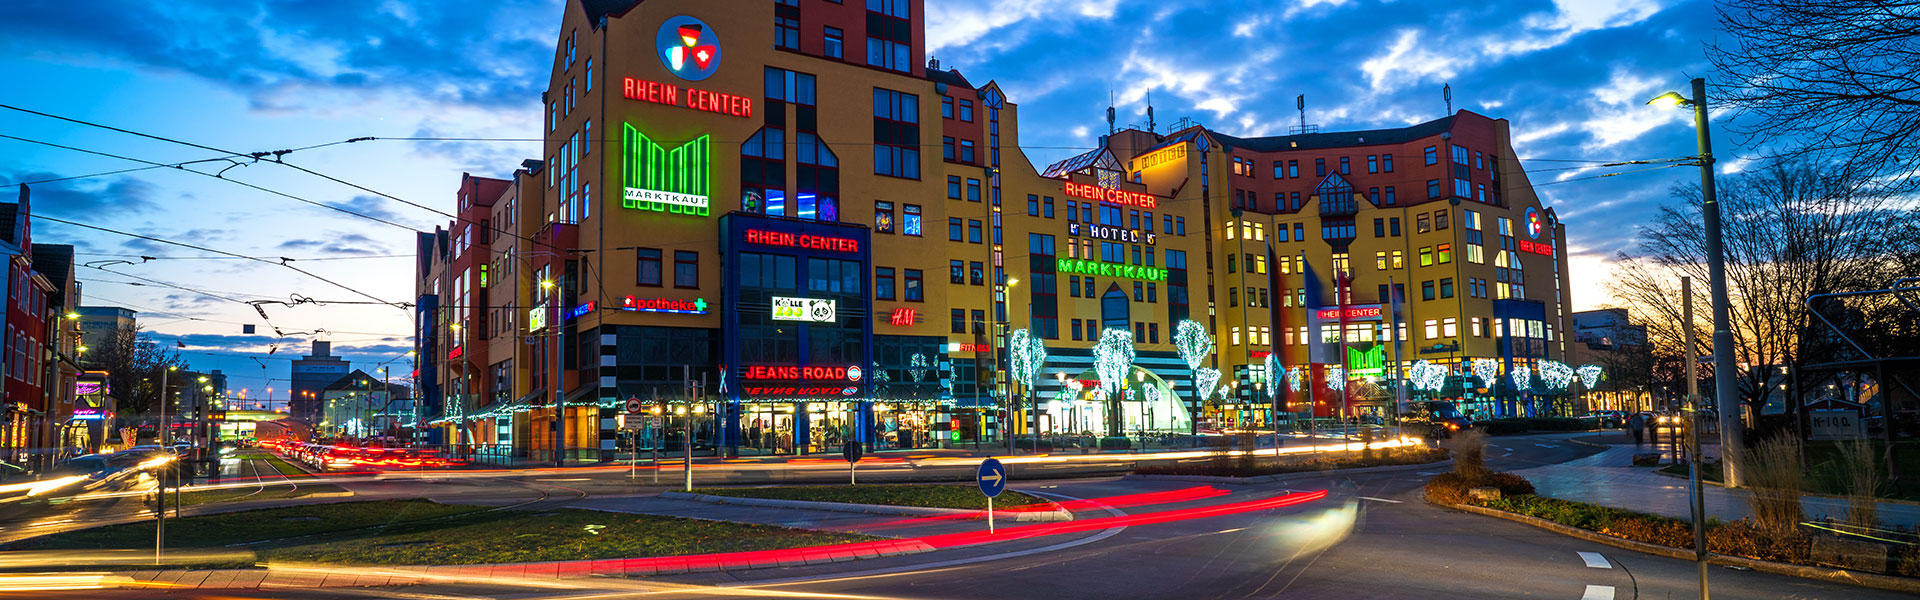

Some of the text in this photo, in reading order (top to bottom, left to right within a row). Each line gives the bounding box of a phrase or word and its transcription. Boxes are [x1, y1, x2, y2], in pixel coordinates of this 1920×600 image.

[624, 77, 751, 118] RHEIN CENTER
[1142, 145, 1186, 169] HOTEL
[625, 189, 708, 205] MARKTKAUF
[1065, 181, 1156, 209] RHEIN CENTER
[747, 229, 858, 252] RHEIN CENTER
[1090, 225, 1138, 243] HOTEL
[1519, 239, 1552, 256] RHEIN CENTER
[1058, 259, 1168, 281] MARKTKAUF
[624, 294, 696, 310] Apotheke
[1345, 307, 1380, 319] CENTER
[960, 343, 990, 352] FITNESS
[745, 366, 846, 380] JEANS ROAD
